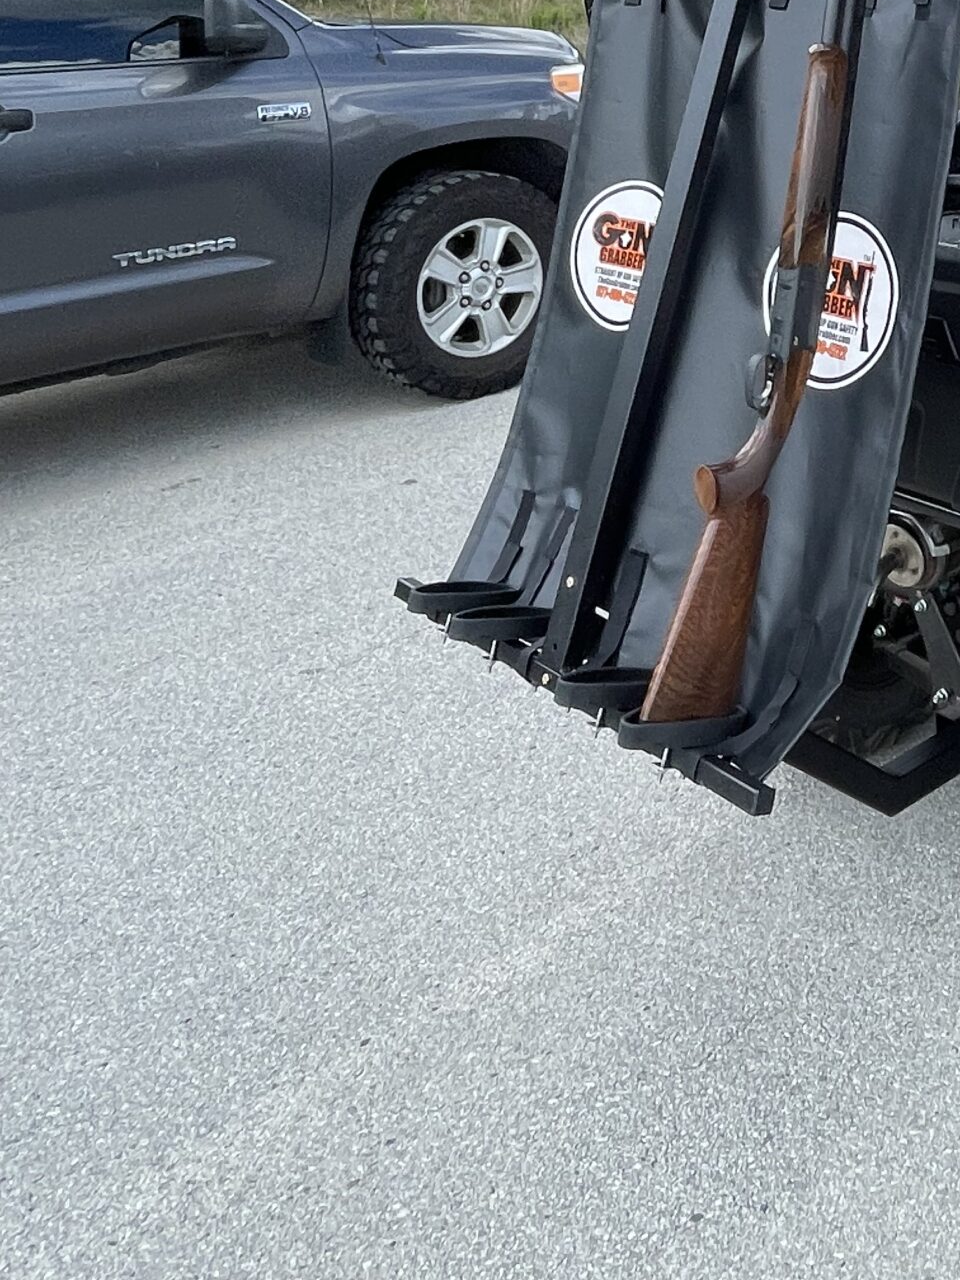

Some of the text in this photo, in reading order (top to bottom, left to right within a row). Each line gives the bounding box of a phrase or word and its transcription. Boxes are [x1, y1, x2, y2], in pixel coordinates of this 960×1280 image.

[620, 219, 636, 229] THE
[112, 236, 237, 267] TUNDRA
[600, 246, 643, 269] GRABBER
[823, 295, 853, 317] BBER
